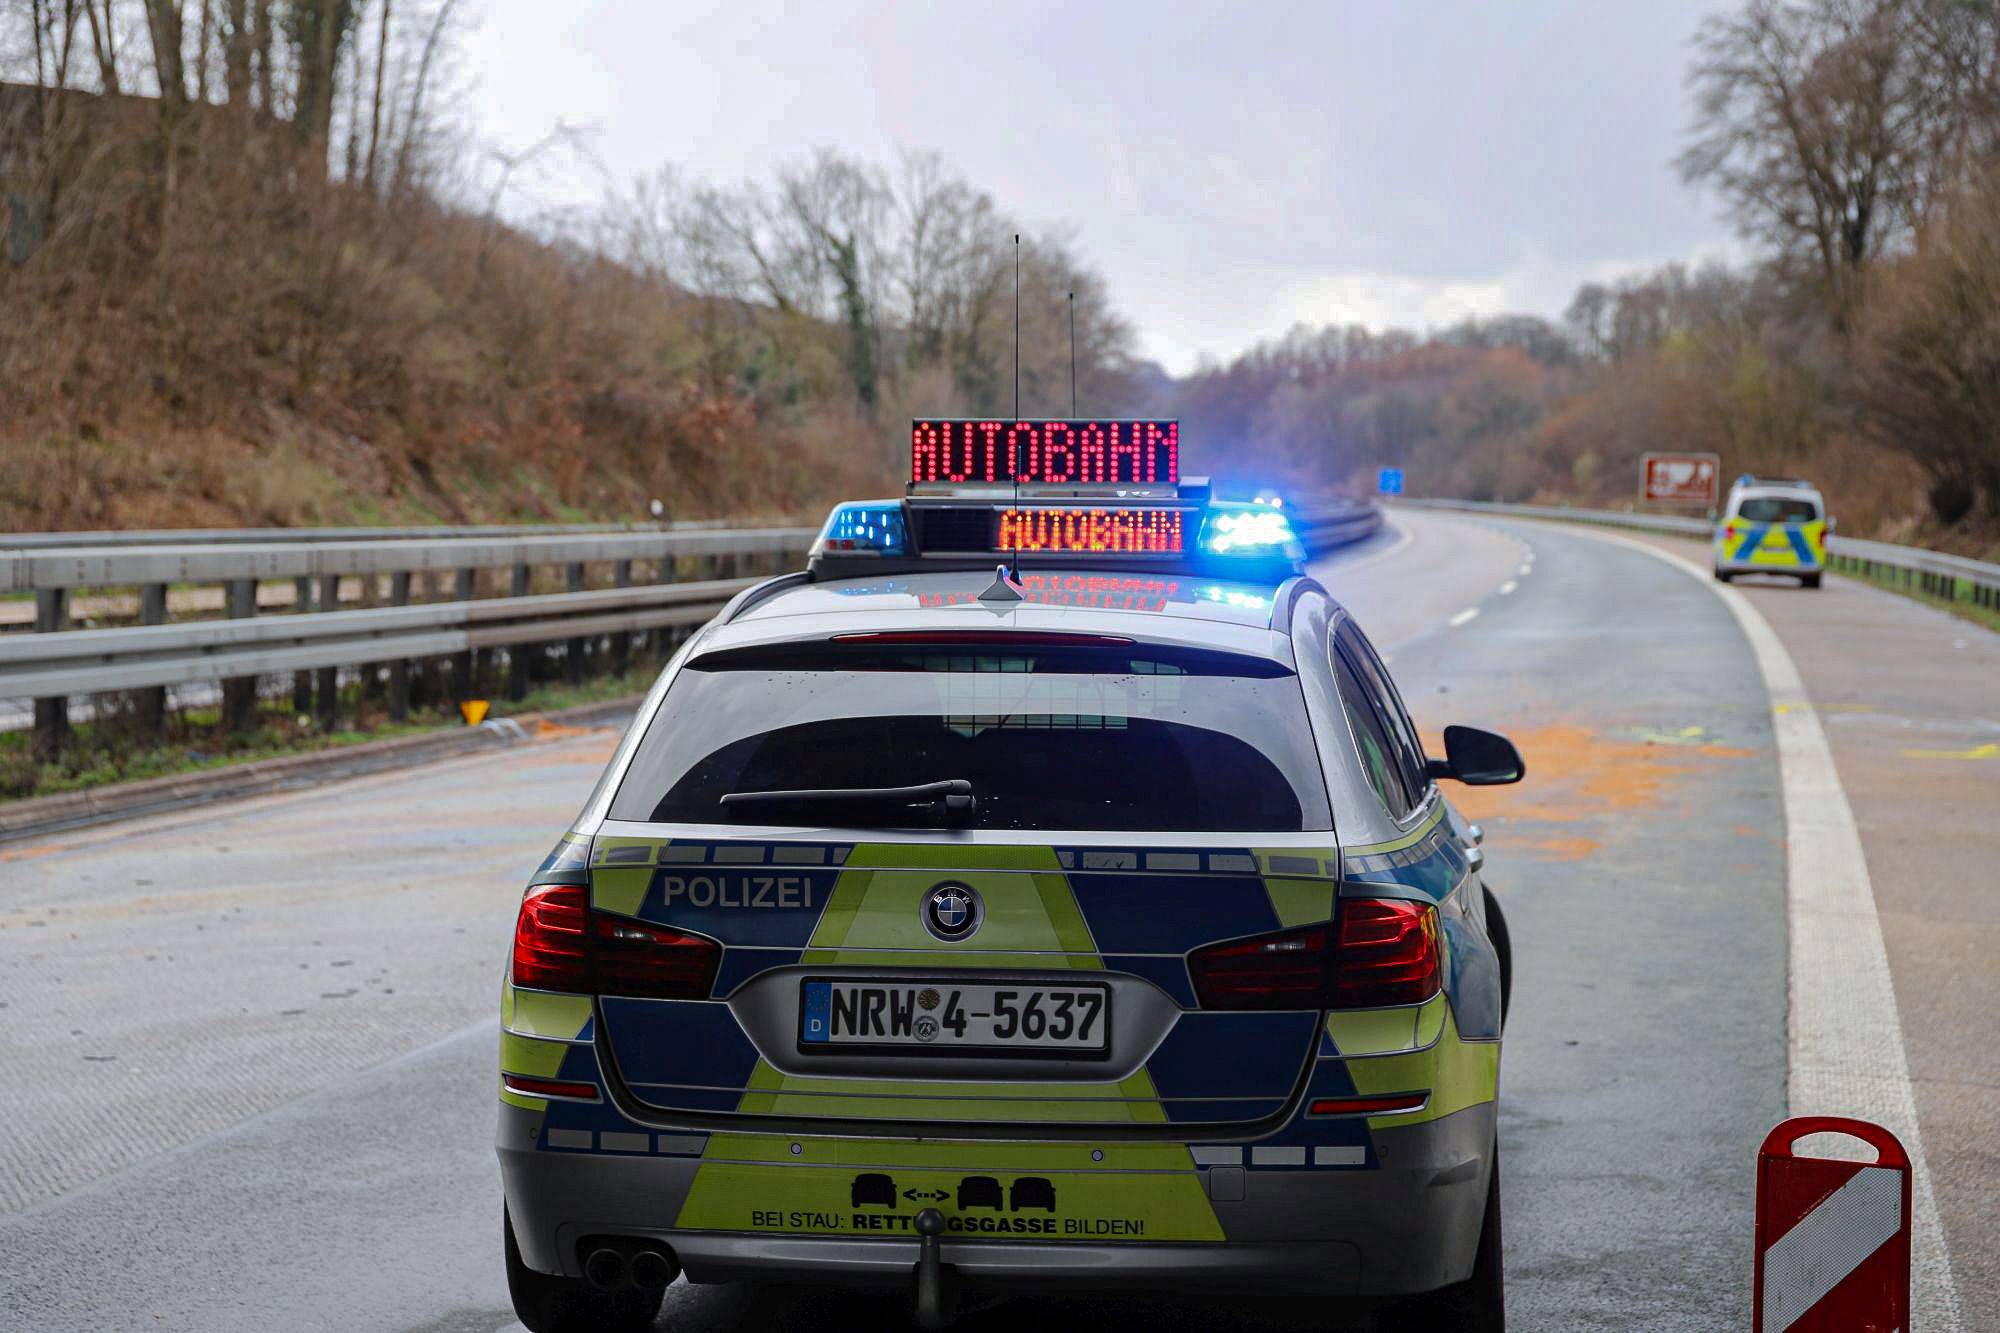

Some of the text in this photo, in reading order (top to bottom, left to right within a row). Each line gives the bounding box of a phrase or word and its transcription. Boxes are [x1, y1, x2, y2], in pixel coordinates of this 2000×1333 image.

[913, 422, 1178, 483] AUTOBAHN
[999, 509, 1182, 552] AUTOBAHN
[664, 876, 812, 907] POLIZEI
[934, 888, 972, 904] BMW
[810, 1018, 822, 1032] D
[830, 988, 1102, 1040] NRW 4-5637
[752, 1211, 1144, 1235] BEI STAU: RETTGSGASSE BILDEN!
